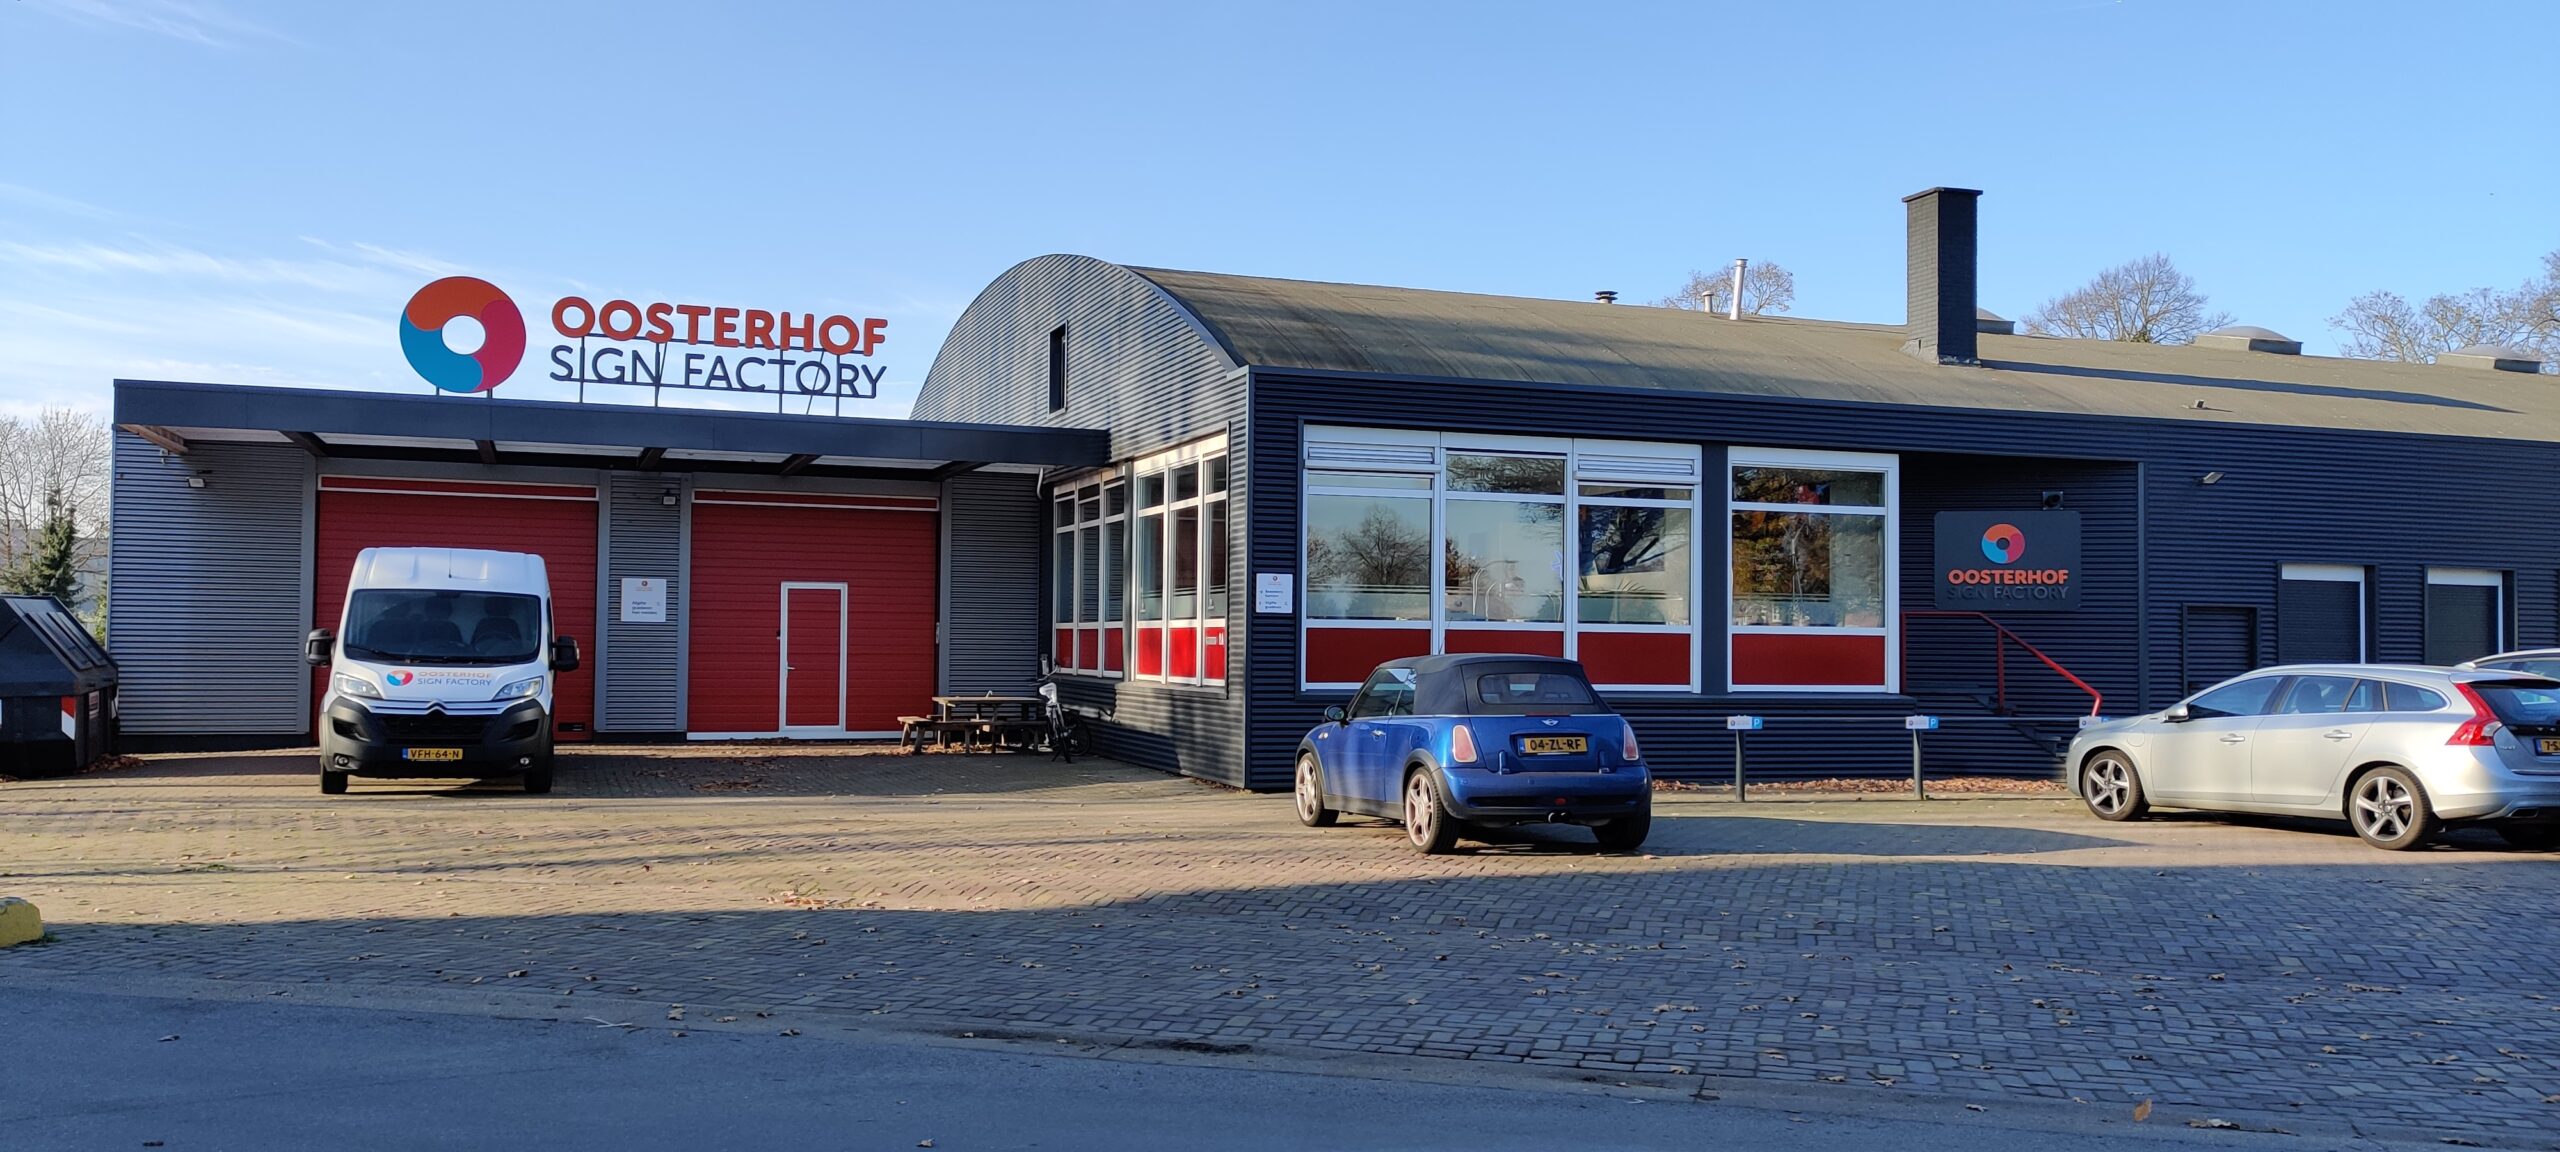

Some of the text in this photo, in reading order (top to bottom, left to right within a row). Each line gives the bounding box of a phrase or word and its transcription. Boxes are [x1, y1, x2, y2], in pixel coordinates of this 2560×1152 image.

[552, 296, 888, 357] OOSTERHOF
[550, 344, 887, 399] SIGN FACTORY
[1948, 569, 2069, 585] OOSTERHOF
[1947, 585, 2069, 600] SIGN FACTORY
[446, 678, 492, 686] FACTORY
[1529, 739, 1581, 751] 04-ZL-RF
[2544, 740, 2560, 751] 7-S
[410, 749, 459, 758] VFH-64-N
